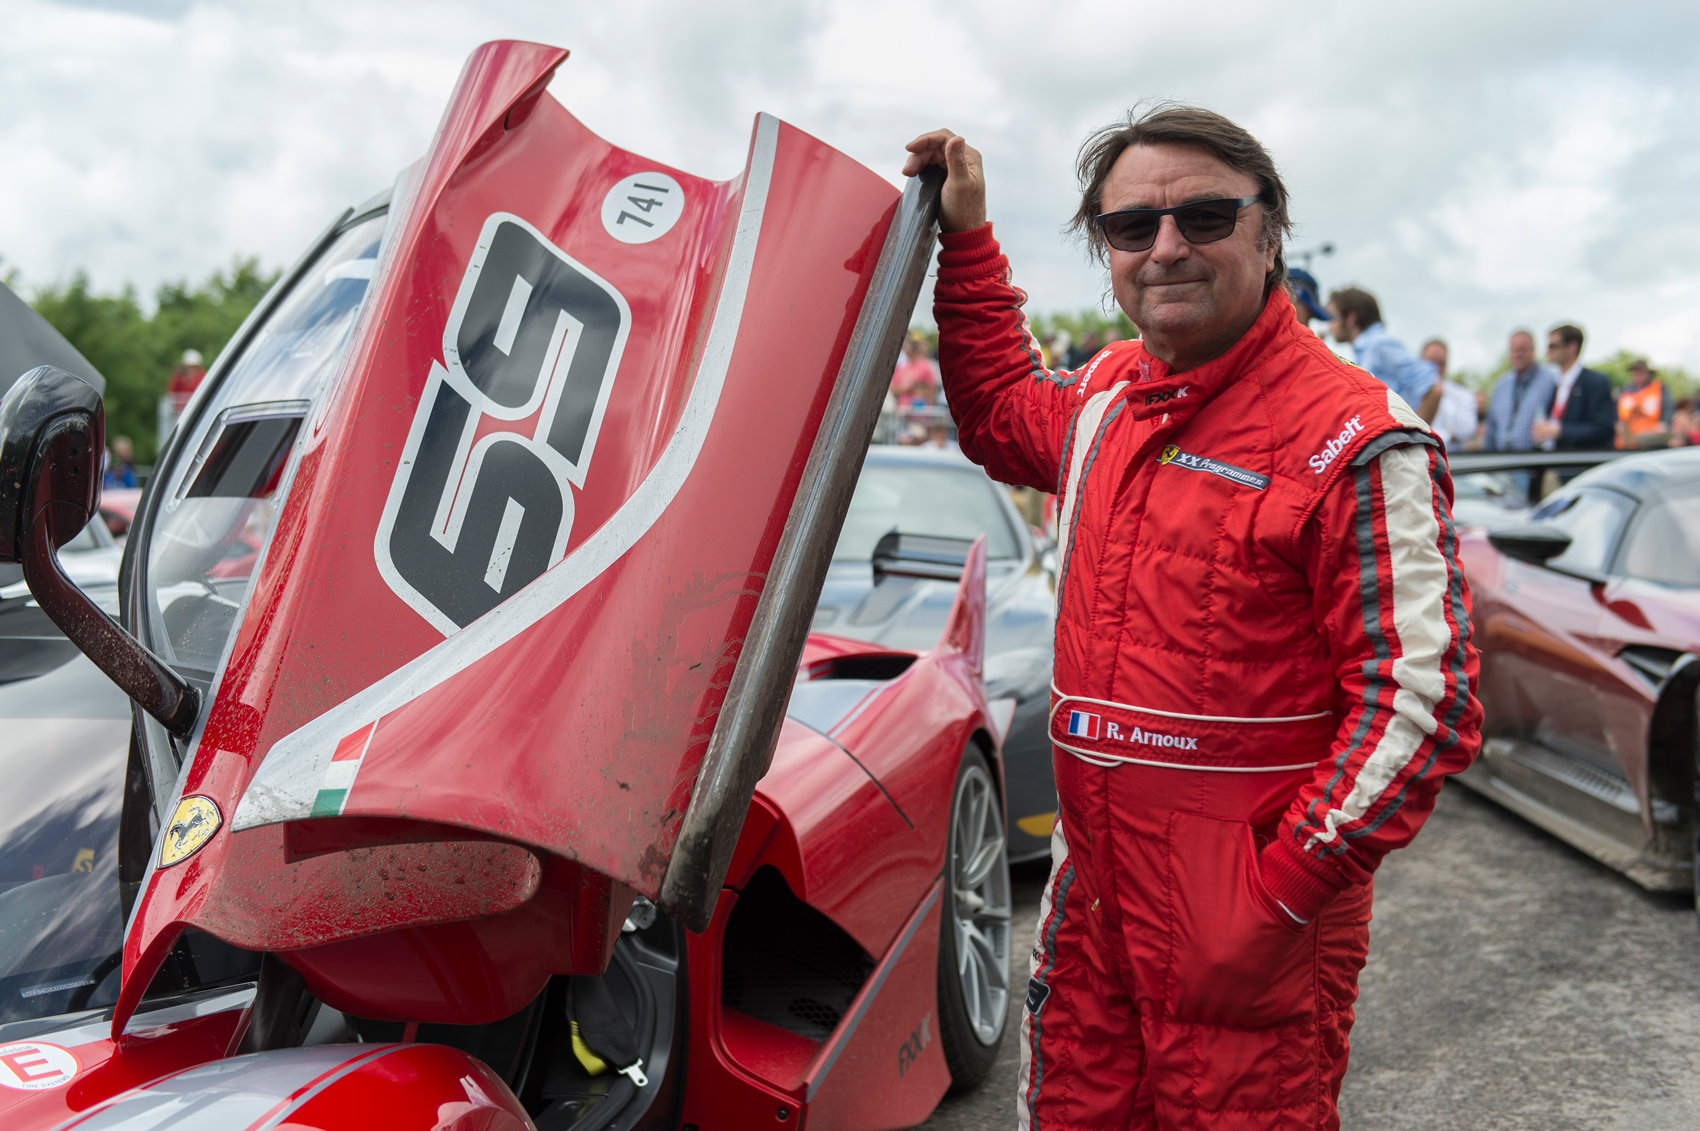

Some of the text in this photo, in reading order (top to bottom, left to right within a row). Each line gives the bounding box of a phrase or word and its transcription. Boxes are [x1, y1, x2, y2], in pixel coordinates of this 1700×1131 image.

[616, 183, 670, 228] 741
[378, 214, 629, 635] 69
[1308, 415, 1365, 474] Sabelt
[1176, 453, 1264, 486] XX Programmes
[1106, 721, 1199, 750] R. Arnoux
[0, 1048, 64, 1083] E
